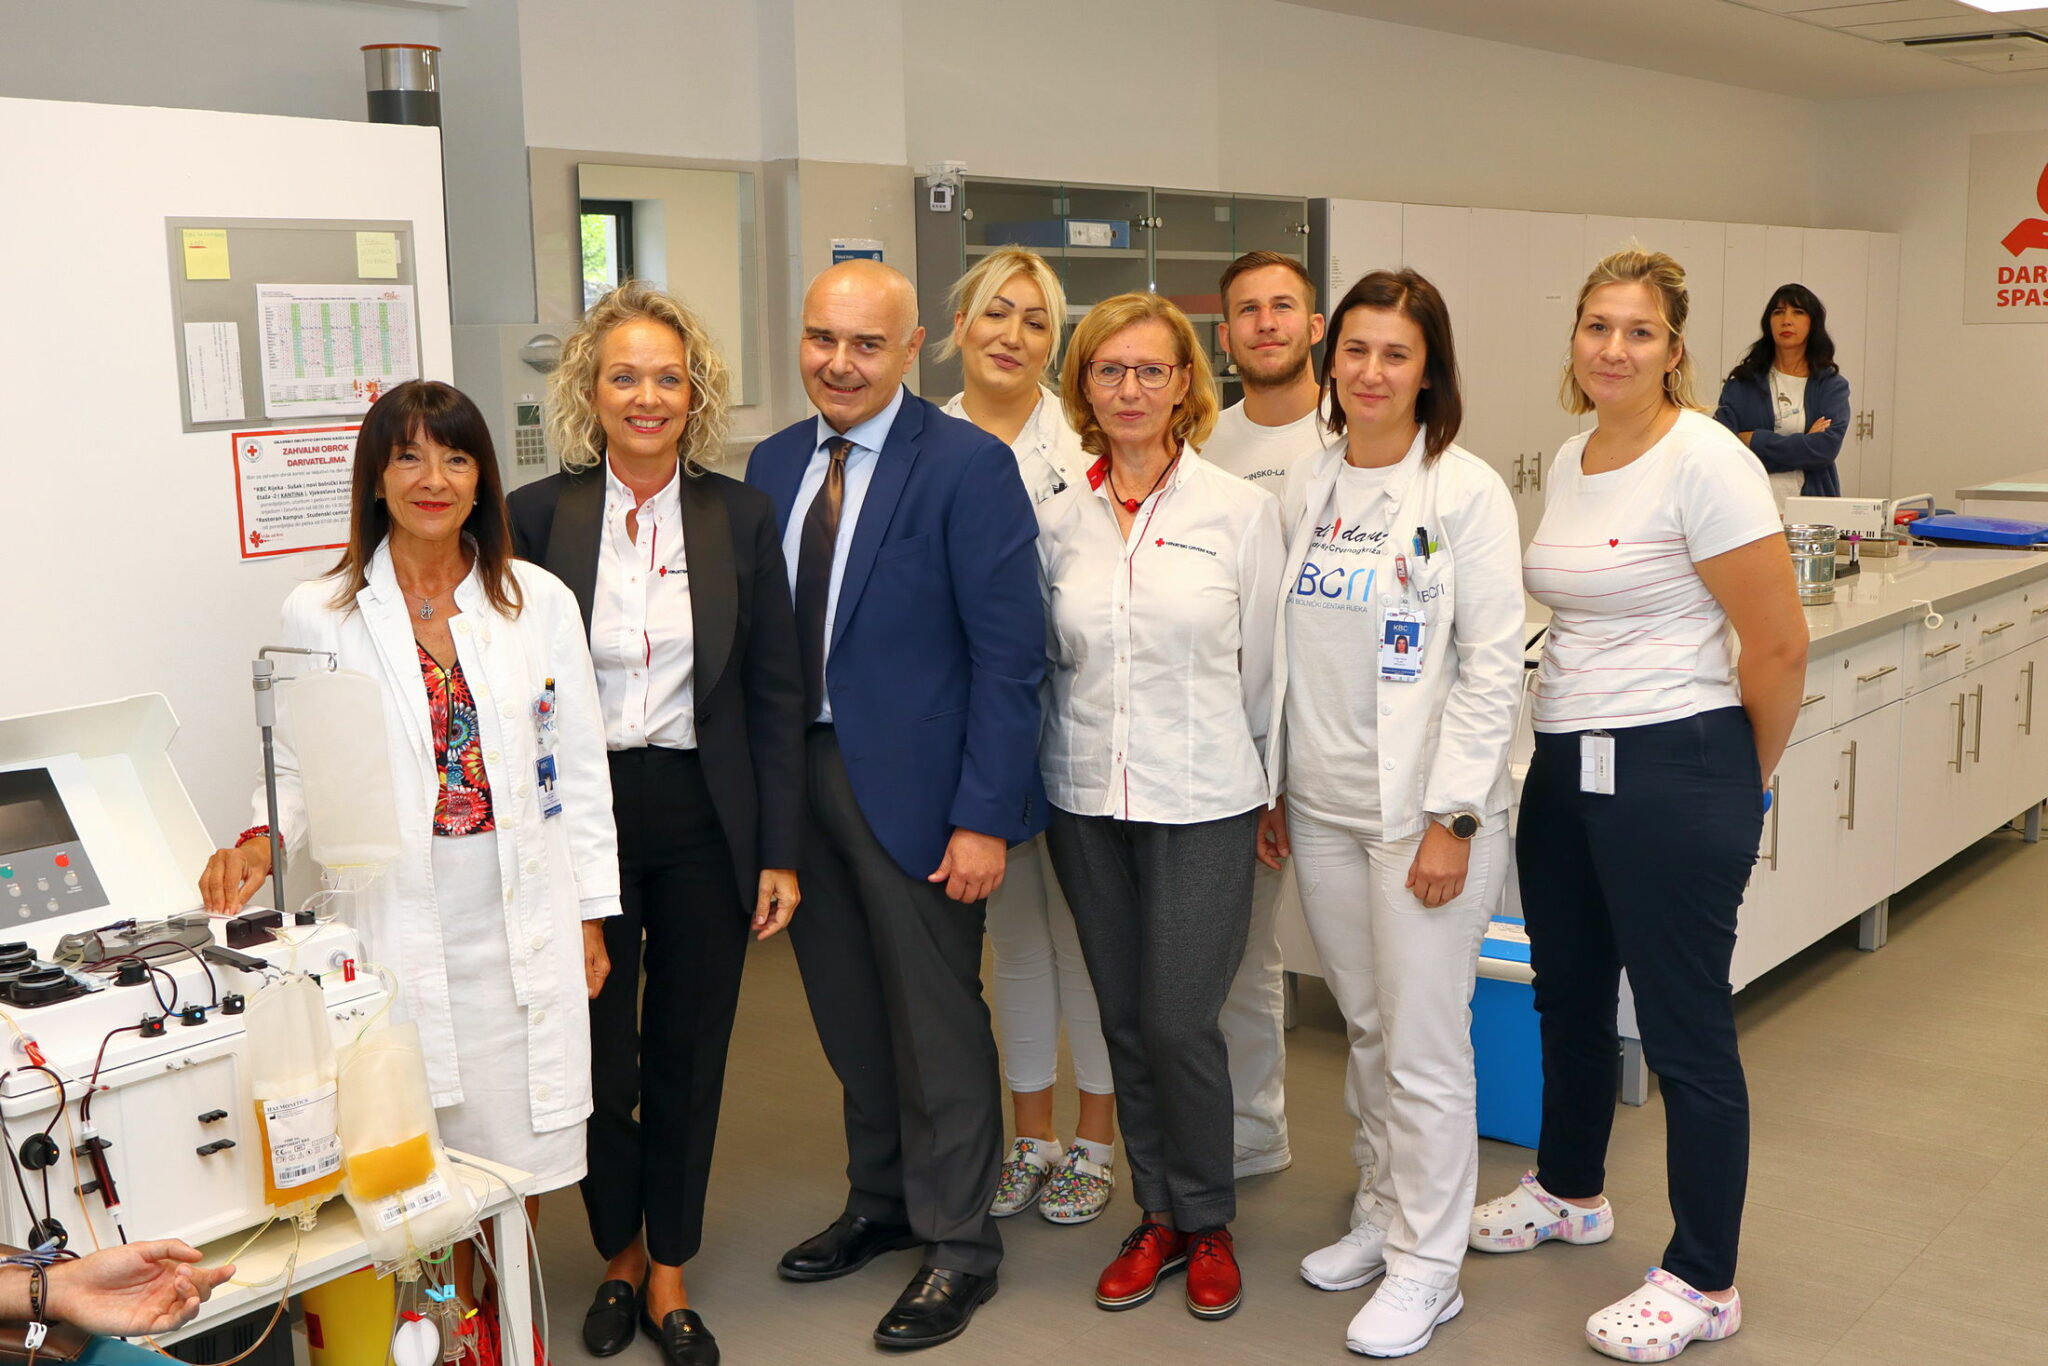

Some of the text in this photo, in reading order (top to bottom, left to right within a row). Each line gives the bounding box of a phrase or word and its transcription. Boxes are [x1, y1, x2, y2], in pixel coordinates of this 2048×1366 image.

[1998, 265, 2048, 284] DAR
[283, 444, 349, 455] ZAHVALNI OBROK
[287, 456, 346, 467] DARIVATELJIMA
[1296, 599, 1321, 608] BOLNIČKI
[1323, 601, 1345, 610] CENTAR
